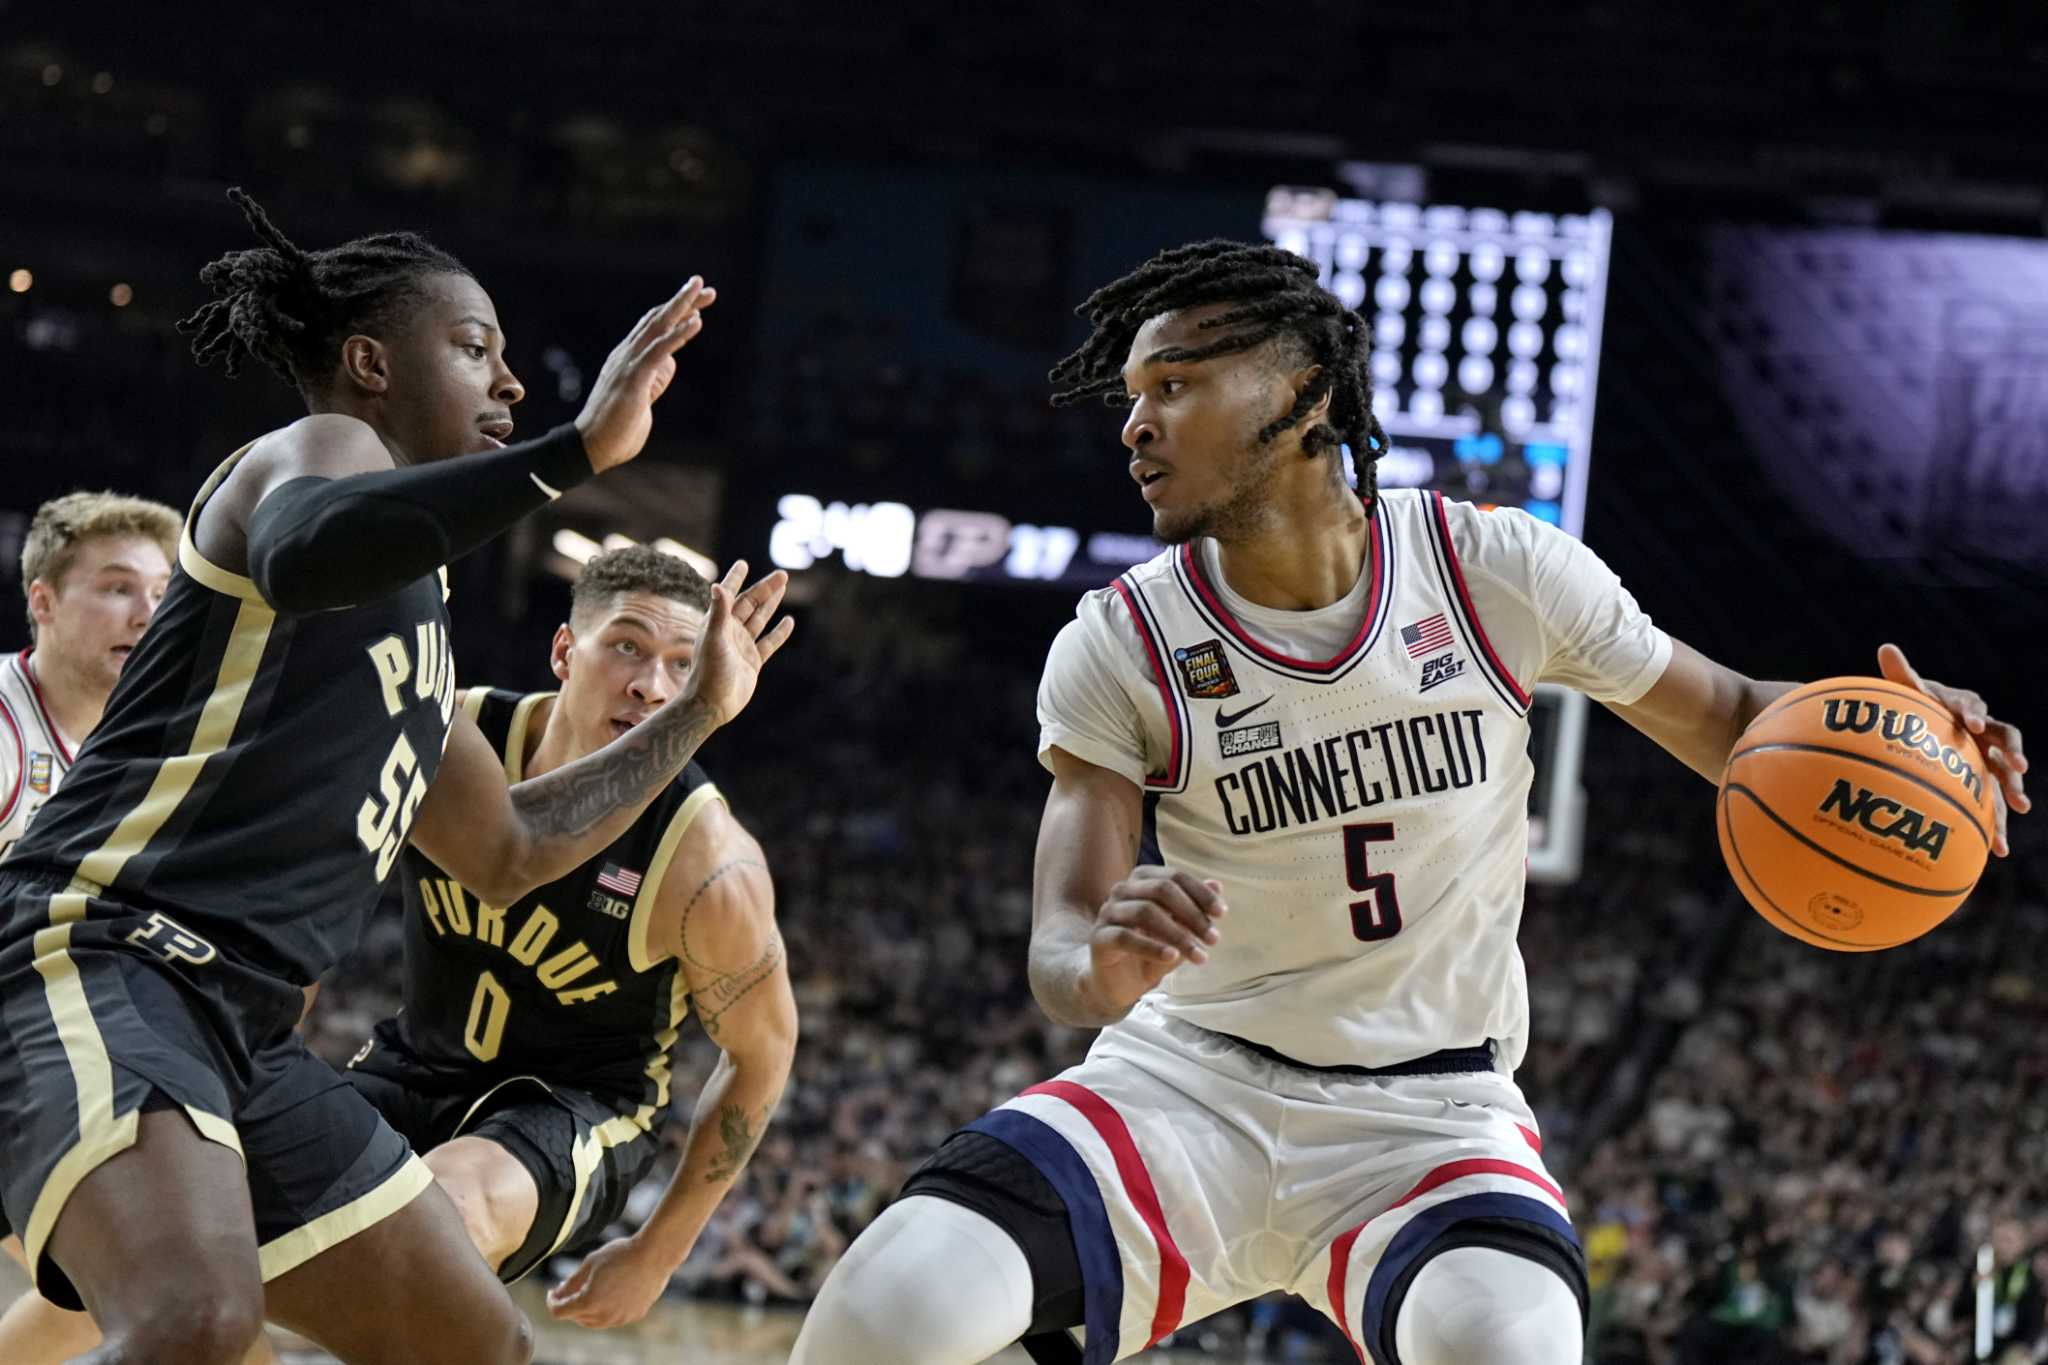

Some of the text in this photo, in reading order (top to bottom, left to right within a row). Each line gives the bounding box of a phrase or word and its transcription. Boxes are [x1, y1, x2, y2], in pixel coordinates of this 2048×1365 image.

[1185, 650, 1218, 672] FINAL
[1190, 663, 1222, 684] FOUR
[1420, 659, 1466, 687] EAST
[1422, 652, 1453, 675] BIG
[1222, 736, 1280, 756] CHANGE
[1233, 727, 1261, 744] BE
[1824, 699, 1983, 803] Wilson
[1215, 710, 1487, 835] CONNECTICUT
[1818, 777, 1950, 862] NCAA
[1342, 821, 1402, 942] 5
[419, 877, 618, 1006] PURDUE
[464, 970, 511, 1063] 0
